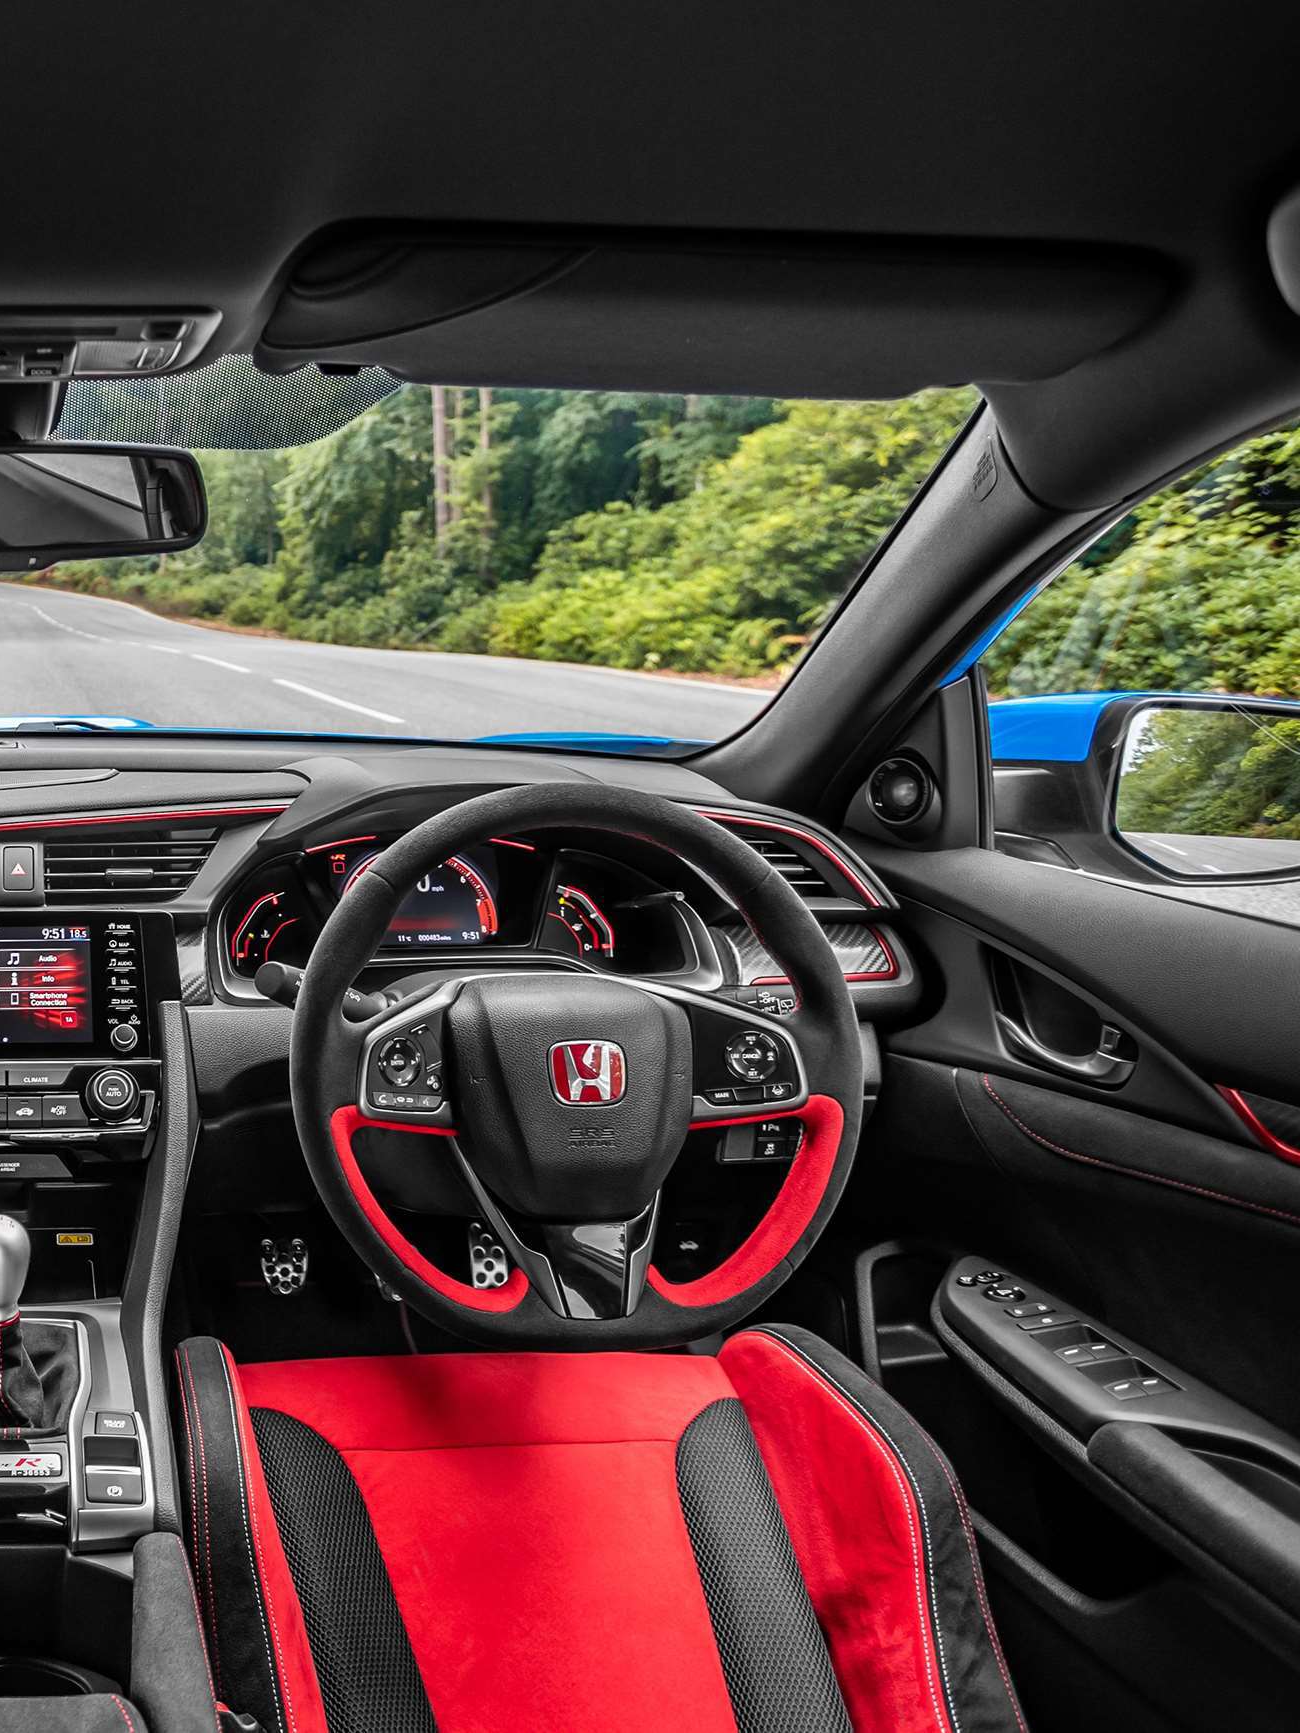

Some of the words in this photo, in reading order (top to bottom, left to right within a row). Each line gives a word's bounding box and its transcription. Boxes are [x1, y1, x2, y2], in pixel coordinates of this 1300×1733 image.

[460, 875, 467, 884] 6
[41, 927, 66, 939] 9:51
[461, 931, 480, 940] 9:51
[29, 992, 68, 1000] Smartphone
[568, 1127, 615, 1139] SRS
